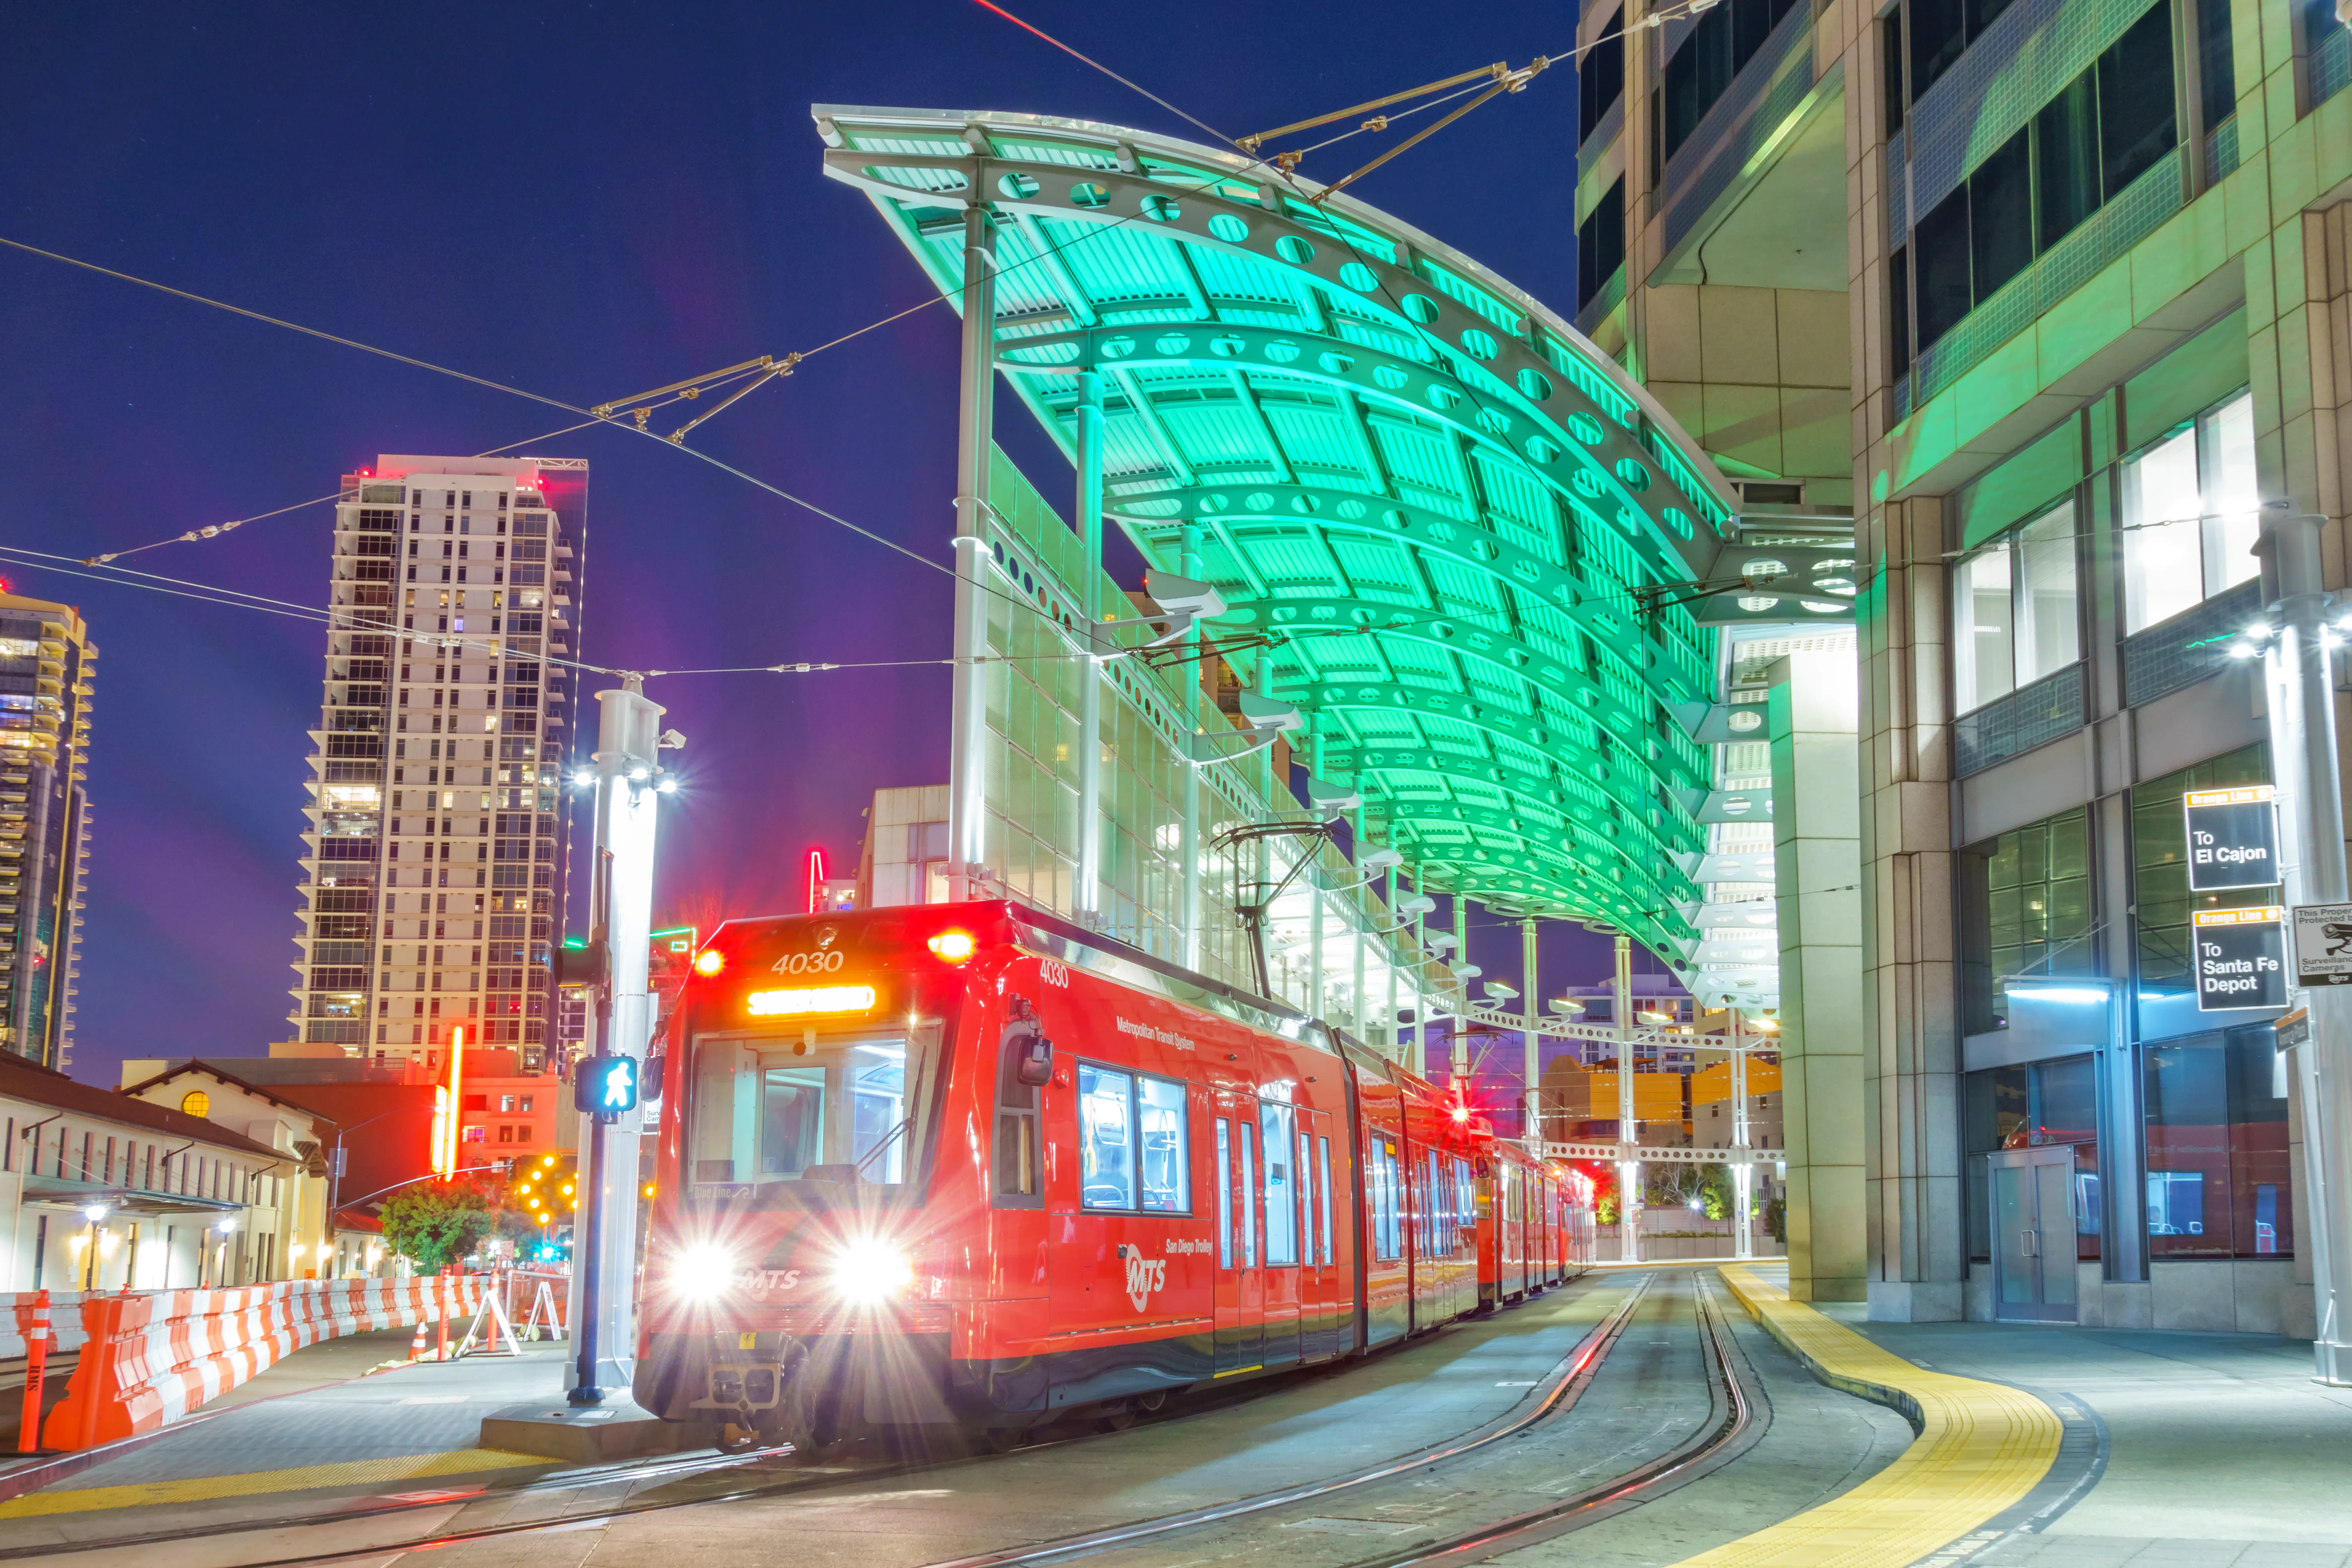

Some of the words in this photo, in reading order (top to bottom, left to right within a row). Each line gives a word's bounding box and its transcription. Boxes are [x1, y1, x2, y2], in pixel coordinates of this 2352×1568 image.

[2191, 793, 2228, 805] Orange
[2230, 791, 2254, 802] Line
[2193, 830, 2214, 845] To
[2196, 848, 2213, 864] El
[2216, 846, 2267, 864] Cajon
[2199, 913, 2237, 924] Orange
[2239, 911, 2262, 921] Line
[2299, 915, 2345, 924] Protected
[2200, 942, 2222, 957] To
[771, 951, 844, 975] 4030
[2203, 959, 2253, 975] Santa
[2256, 957, 2278, 971] Fe
[1040, 959, 1069, 989] 4030
[2205, 976, 2258, 994] Depot
[1117, 1016, 1155, 1040] Metropolitan
[1154, 1026, 1174, 1046] Transit
[1174, 1032, 1195, 1051] System
[695, 1186, 711, 1198] Blue
[713, 1186, 731, 1198] Line
[1166, 1238, 1177, 1254] San
[1178, 1238, 1194, 1256] Diego
[1195, 1238, 1212, 1256] Trolley
[738, 1269, 801, 1289] MTS
[1126, 1259, 1166, 1293] MTS
